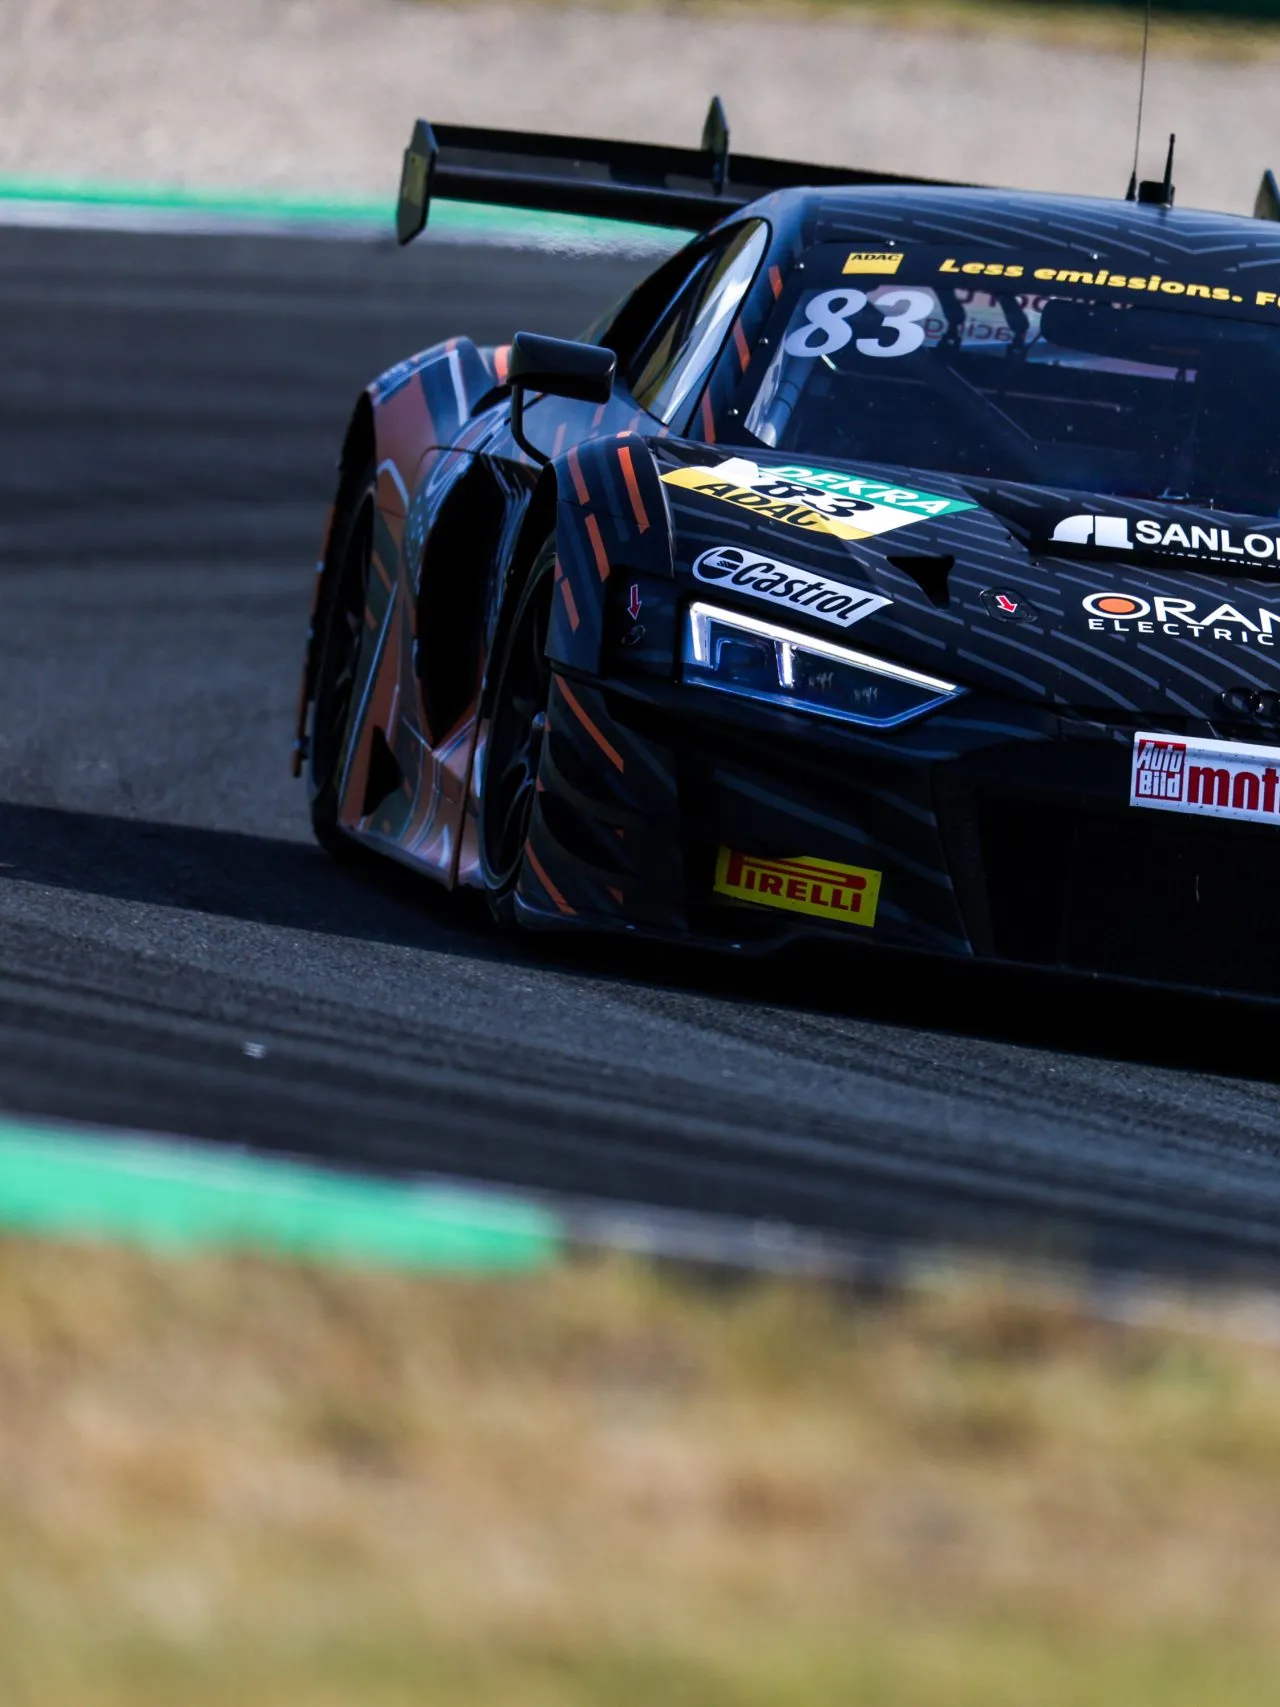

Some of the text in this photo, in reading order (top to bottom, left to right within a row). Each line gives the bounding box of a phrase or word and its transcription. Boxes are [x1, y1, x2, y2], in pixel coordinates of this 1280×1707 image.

[851, 252, 900, 263] ADAC
[938, 258, 1024, 279] Less
[1033, 266, 1244, 302] emissions.
[783, 288, 935, 358] 83
[694, 483, 833, 528] ADAC
[749, 480, 876, 518] 83
[774, 465, 953, 516] DEKRA
[731, 561, 866, 620] Castrol
[1087, 617, 1275, 647] ELECTRIC
[1136, 740, 1186, 771] Auto
[1137, 768, 1182, 799] Bild
[725, 850, 867, 914] PIRELLI
